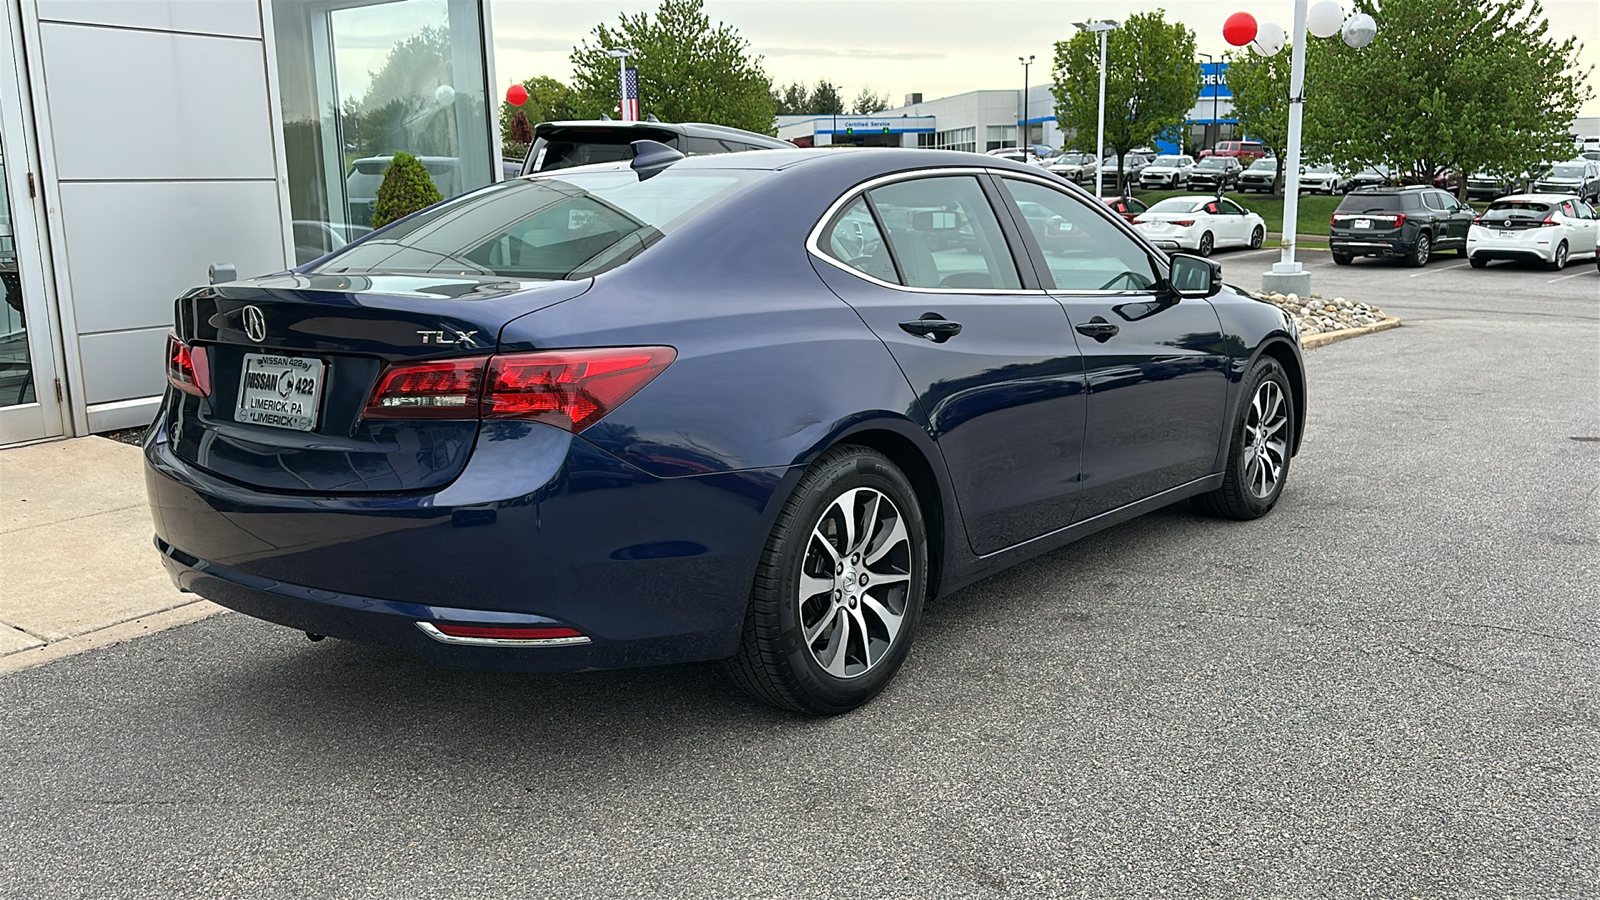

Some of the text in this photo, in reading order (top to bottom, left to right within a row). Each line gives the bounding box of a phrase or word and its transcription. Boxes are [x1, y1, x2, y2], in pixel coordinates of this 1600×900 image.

[416, 330, 478, 344] TLX
[262, 356, 288, 366] NISSAN
[288, 358, 303, 367] 422
[247, 372, 315, 395] NISSAN 422
[291, 402, 302, 415] PA
